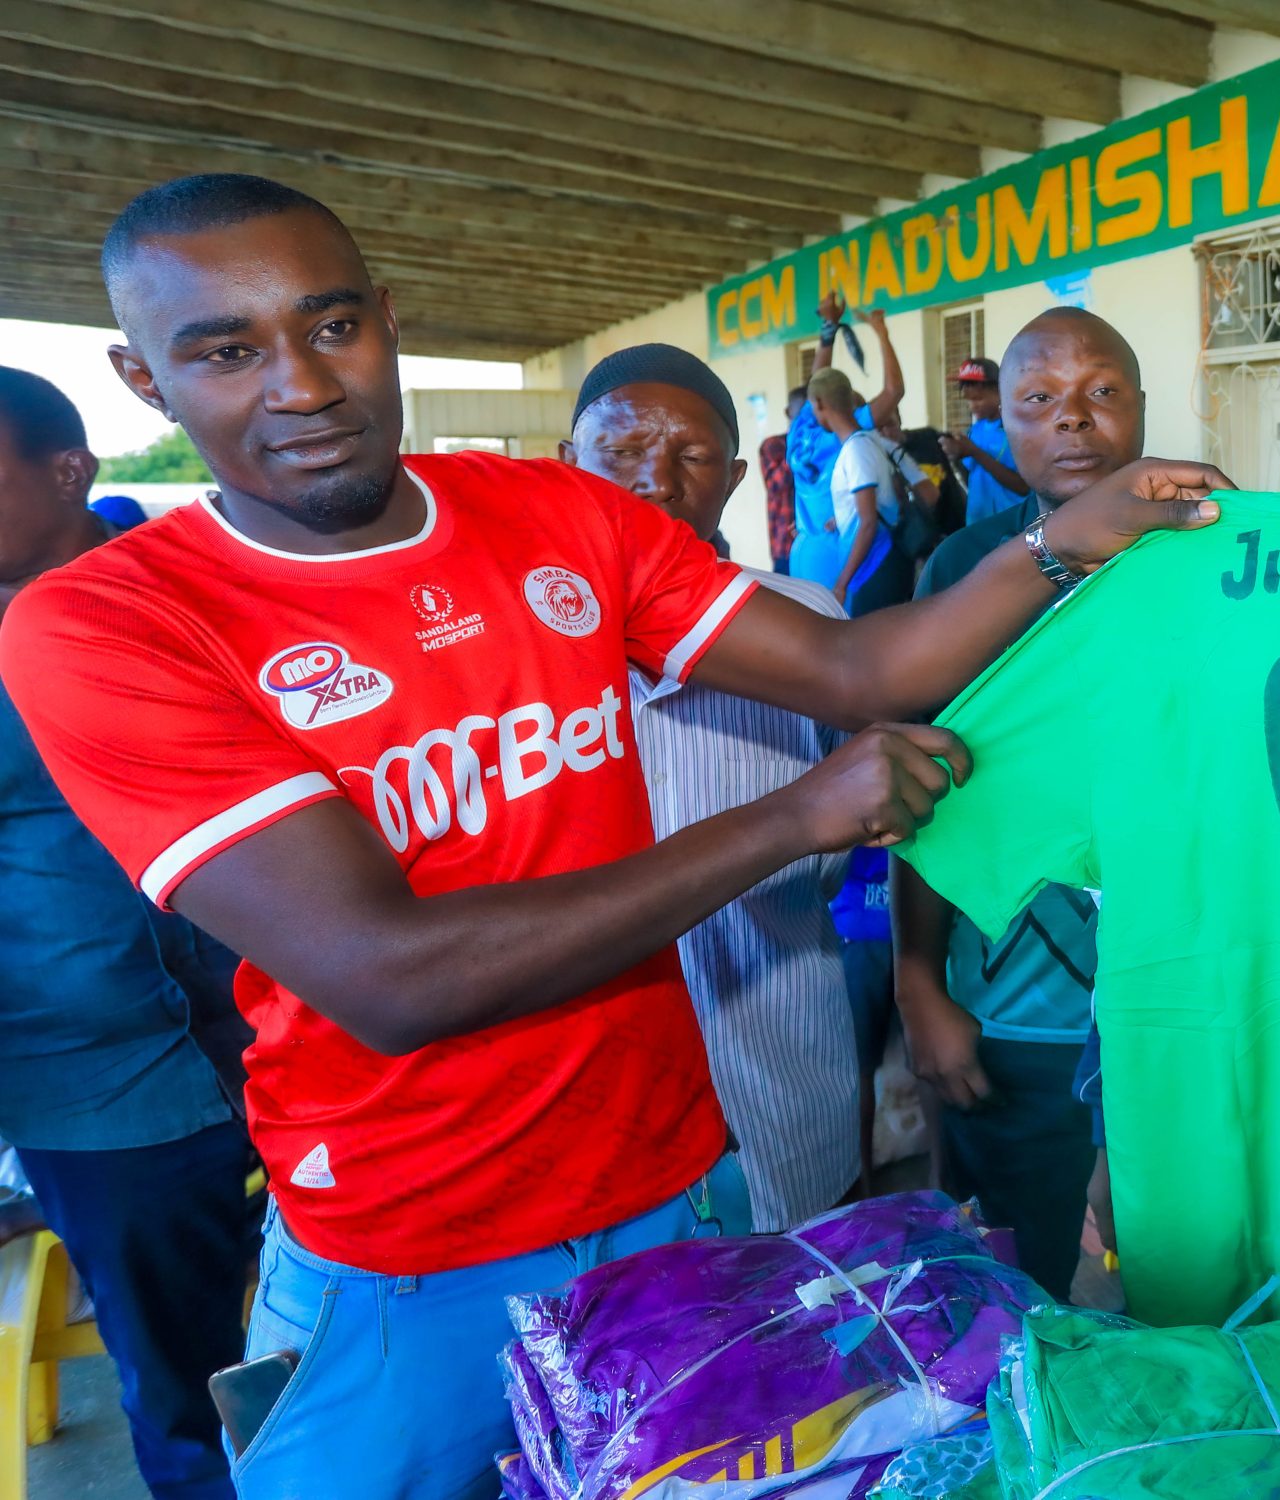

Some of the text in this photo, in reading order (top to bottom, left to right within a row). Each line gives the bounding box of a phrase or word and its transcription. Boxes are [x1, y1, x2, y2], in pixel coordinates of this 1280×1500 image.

[716, 264, 796, 347] CCM
[533, 569, 574, 584] SIMBA
[415, 613, 482, 641] SANDALAND
[421, 622, 485, 653] MOSPORT
[550, 618, 583, 631] SPORTS
[305, 667, 382, 725] XTRA
